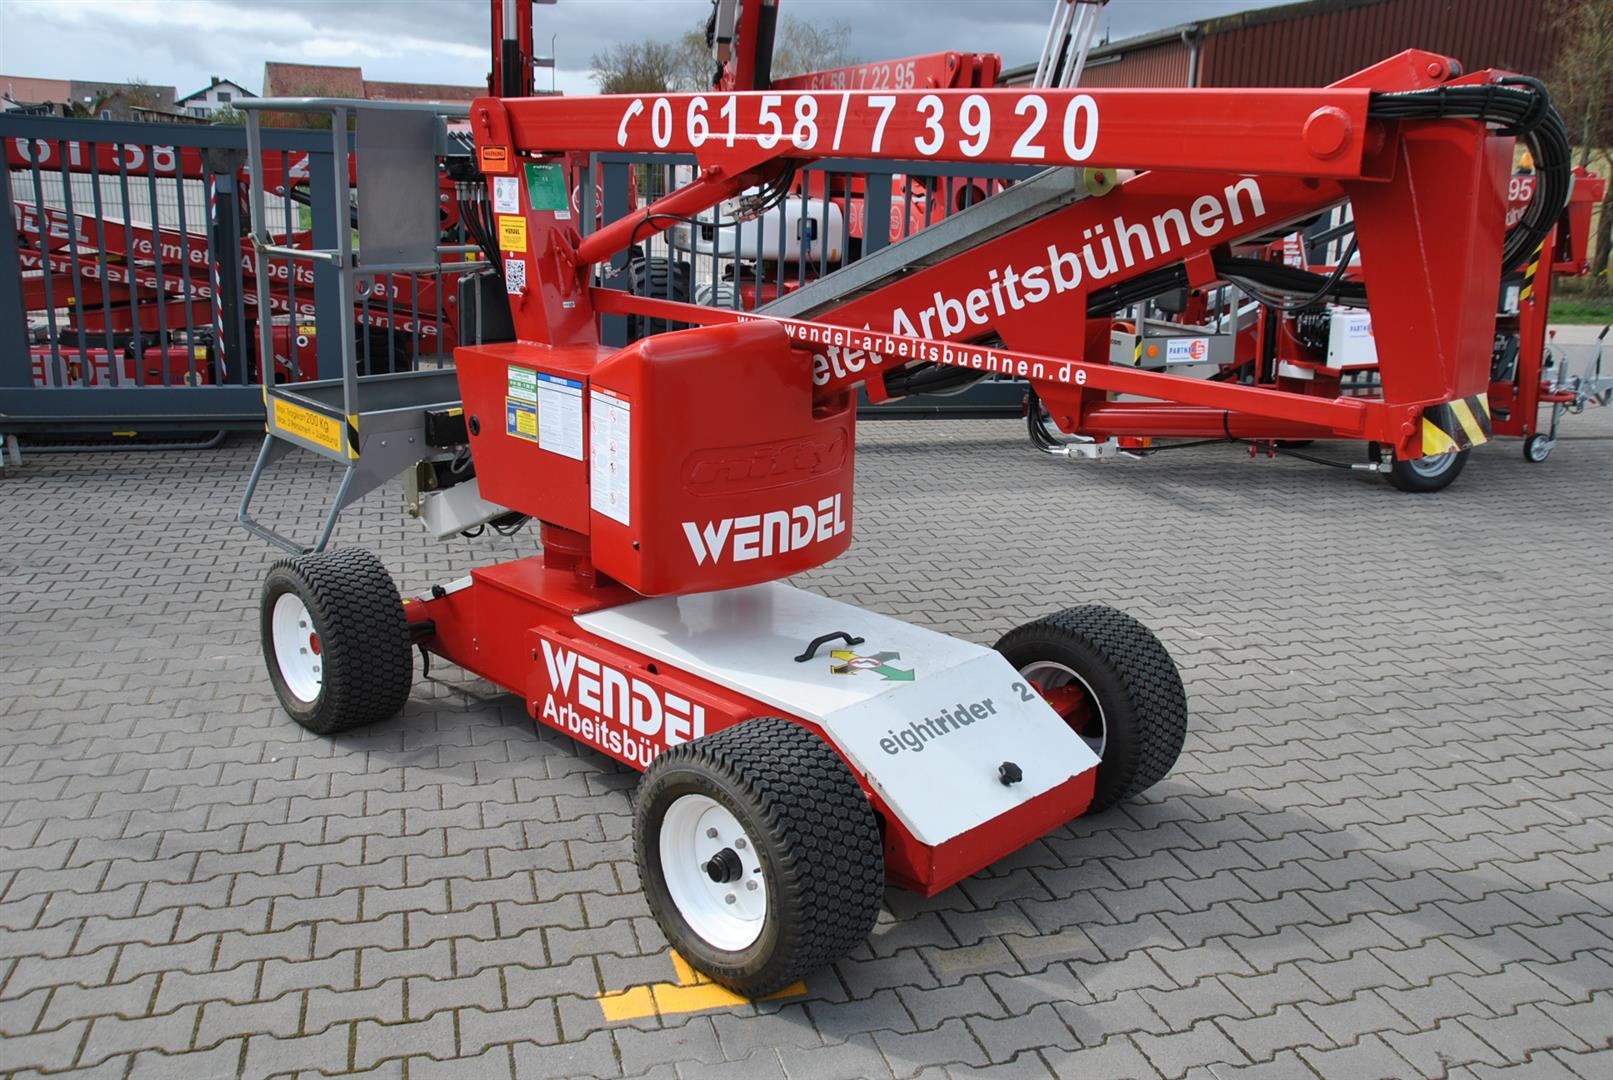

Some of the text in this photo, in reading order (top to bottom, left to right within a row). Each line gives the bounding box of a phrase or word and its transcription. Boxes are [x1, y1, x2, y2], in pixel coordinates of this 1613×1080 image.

[895, 62, 916, 90] 95
[1507, 178, 1532, 201] 95
[893, 176, 1266, 341] Arbeitsbühnen
[681, 492, 846, 567] WENDEL
[879, 681, 1036, 756] eightrider 2
